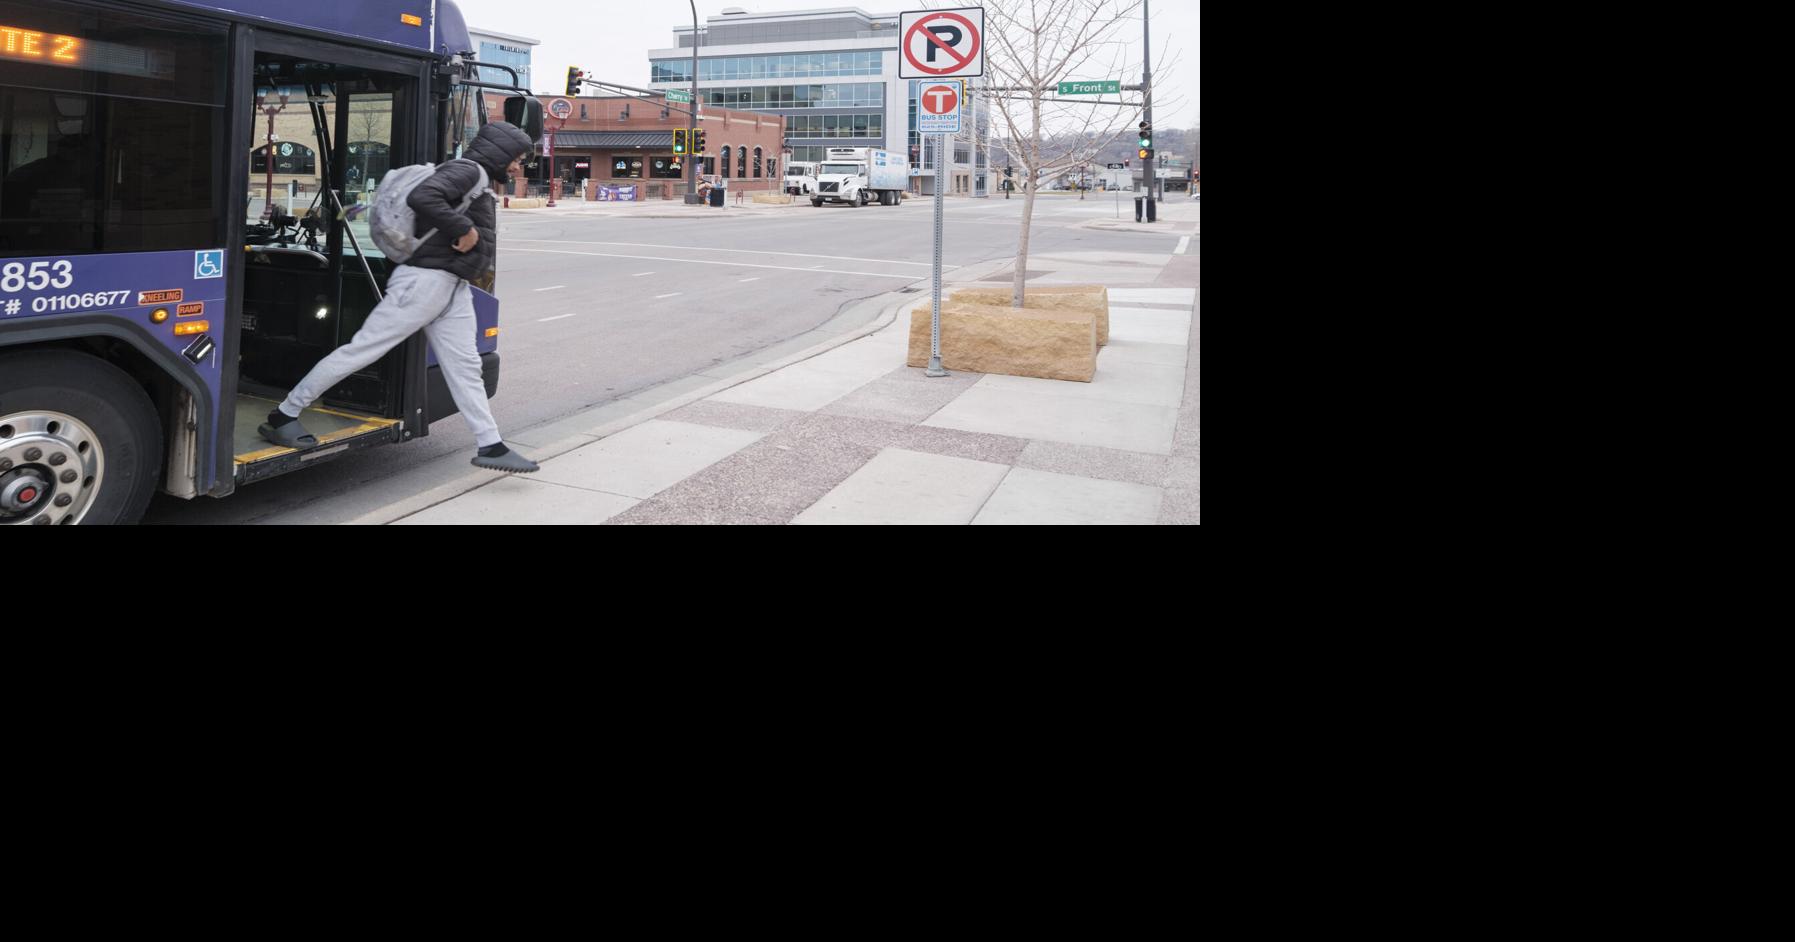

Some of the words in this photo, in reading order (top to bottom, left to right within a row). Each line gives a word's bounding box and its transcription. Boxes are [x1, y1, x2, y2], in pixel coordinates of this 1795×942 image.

[1, 28, 41, 55] TE
[53, 36, 75, 59] 2
[926, 25, 963, 62] P
[1072, 83, 1102, 92] Front
[927, 90, 952, 113] T
[0, 259, 73, 293] 853
[32, 290, 131, 313] 01106677
[179, 304, 202, 315] RAMP
